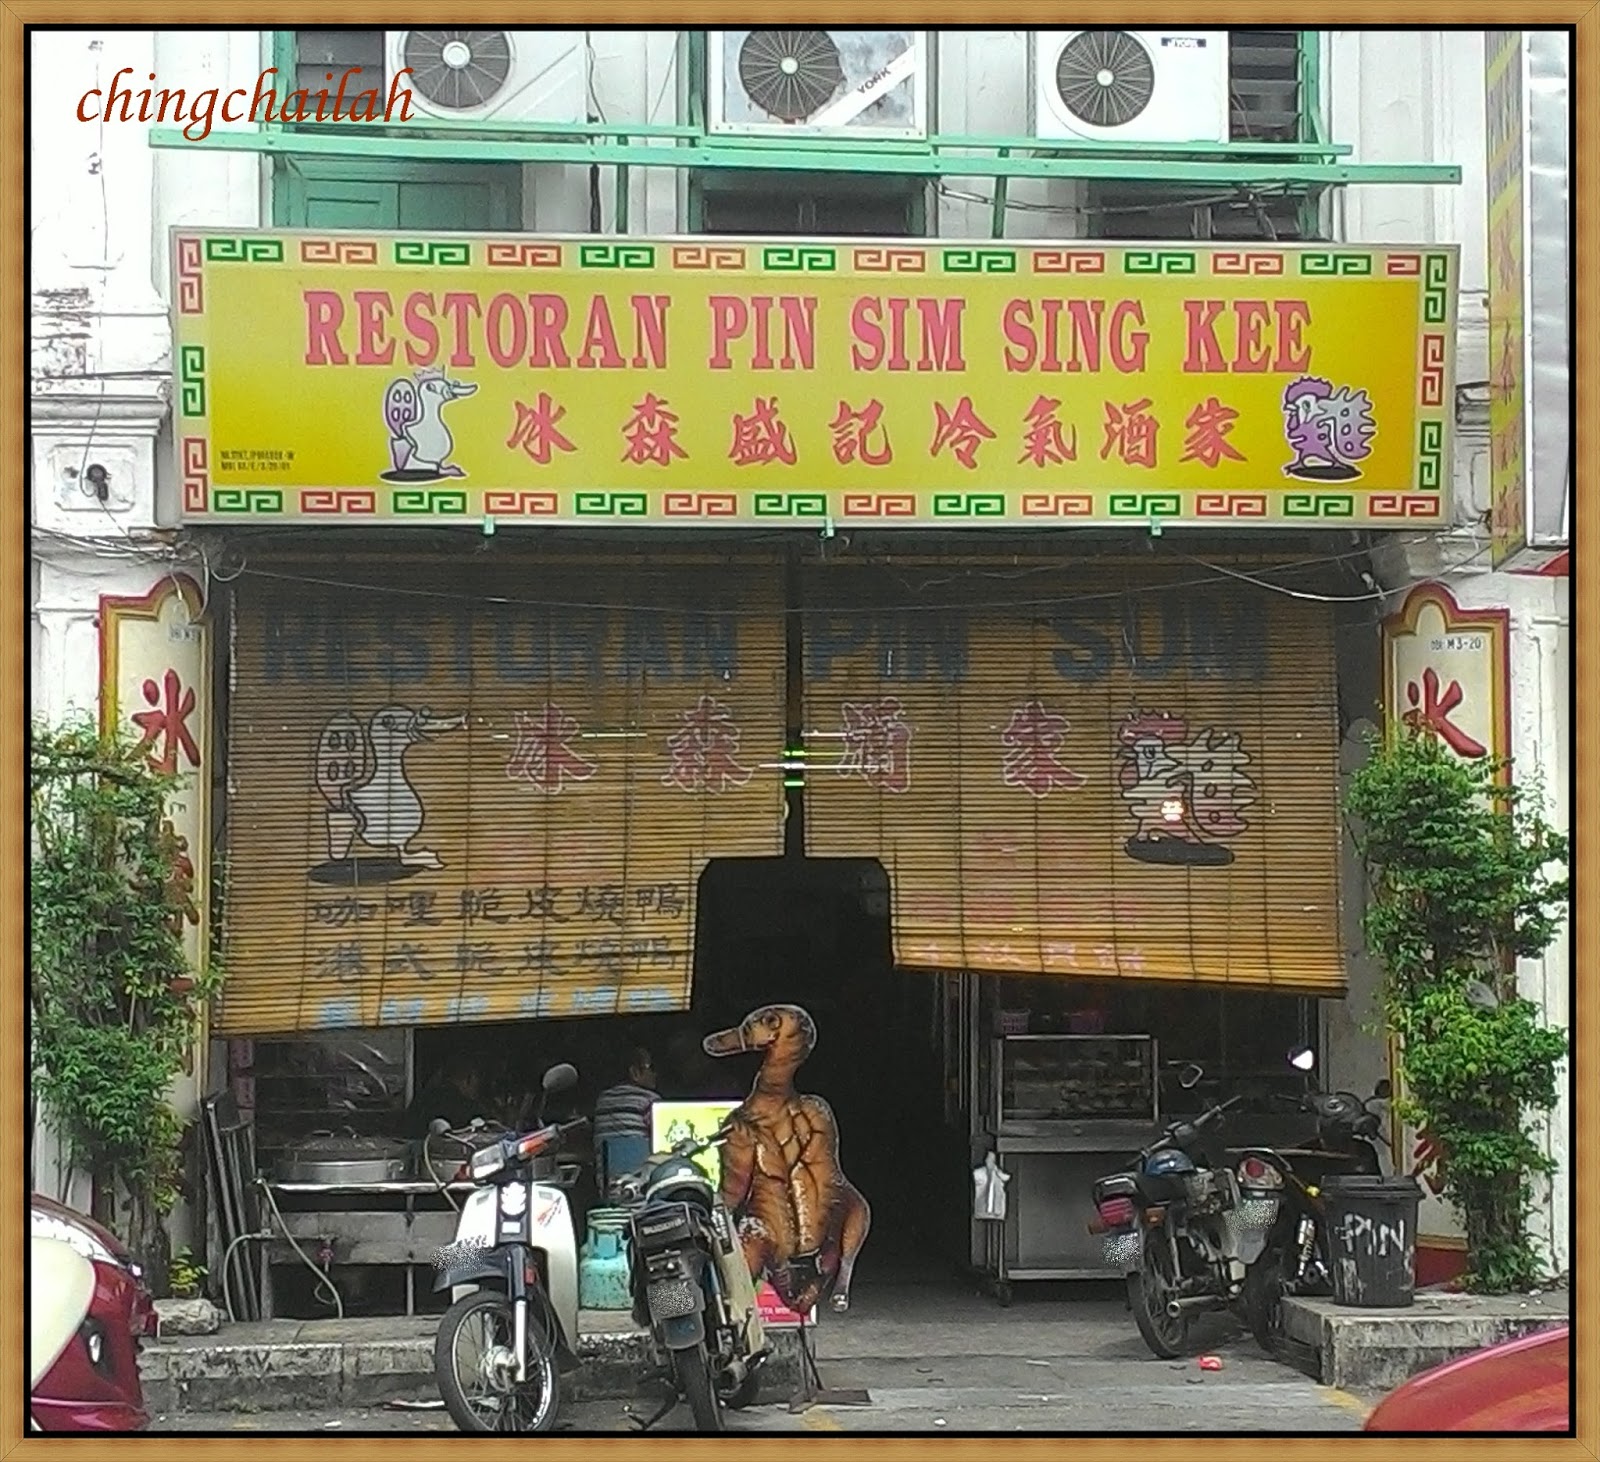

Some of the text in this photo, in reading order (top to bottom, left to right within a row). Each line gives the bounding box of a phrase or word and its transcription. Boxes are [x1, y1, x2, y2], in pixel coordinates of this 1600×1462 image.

[857, 67, 891, 94] YORK
[304, 291, 1309, 373] RESTORAN PIN SIM SING KEE
[506, 392, 1248, 468] 冰森盛記冷氣酒家
[1337, 1213, 1404, 1256] PIN
